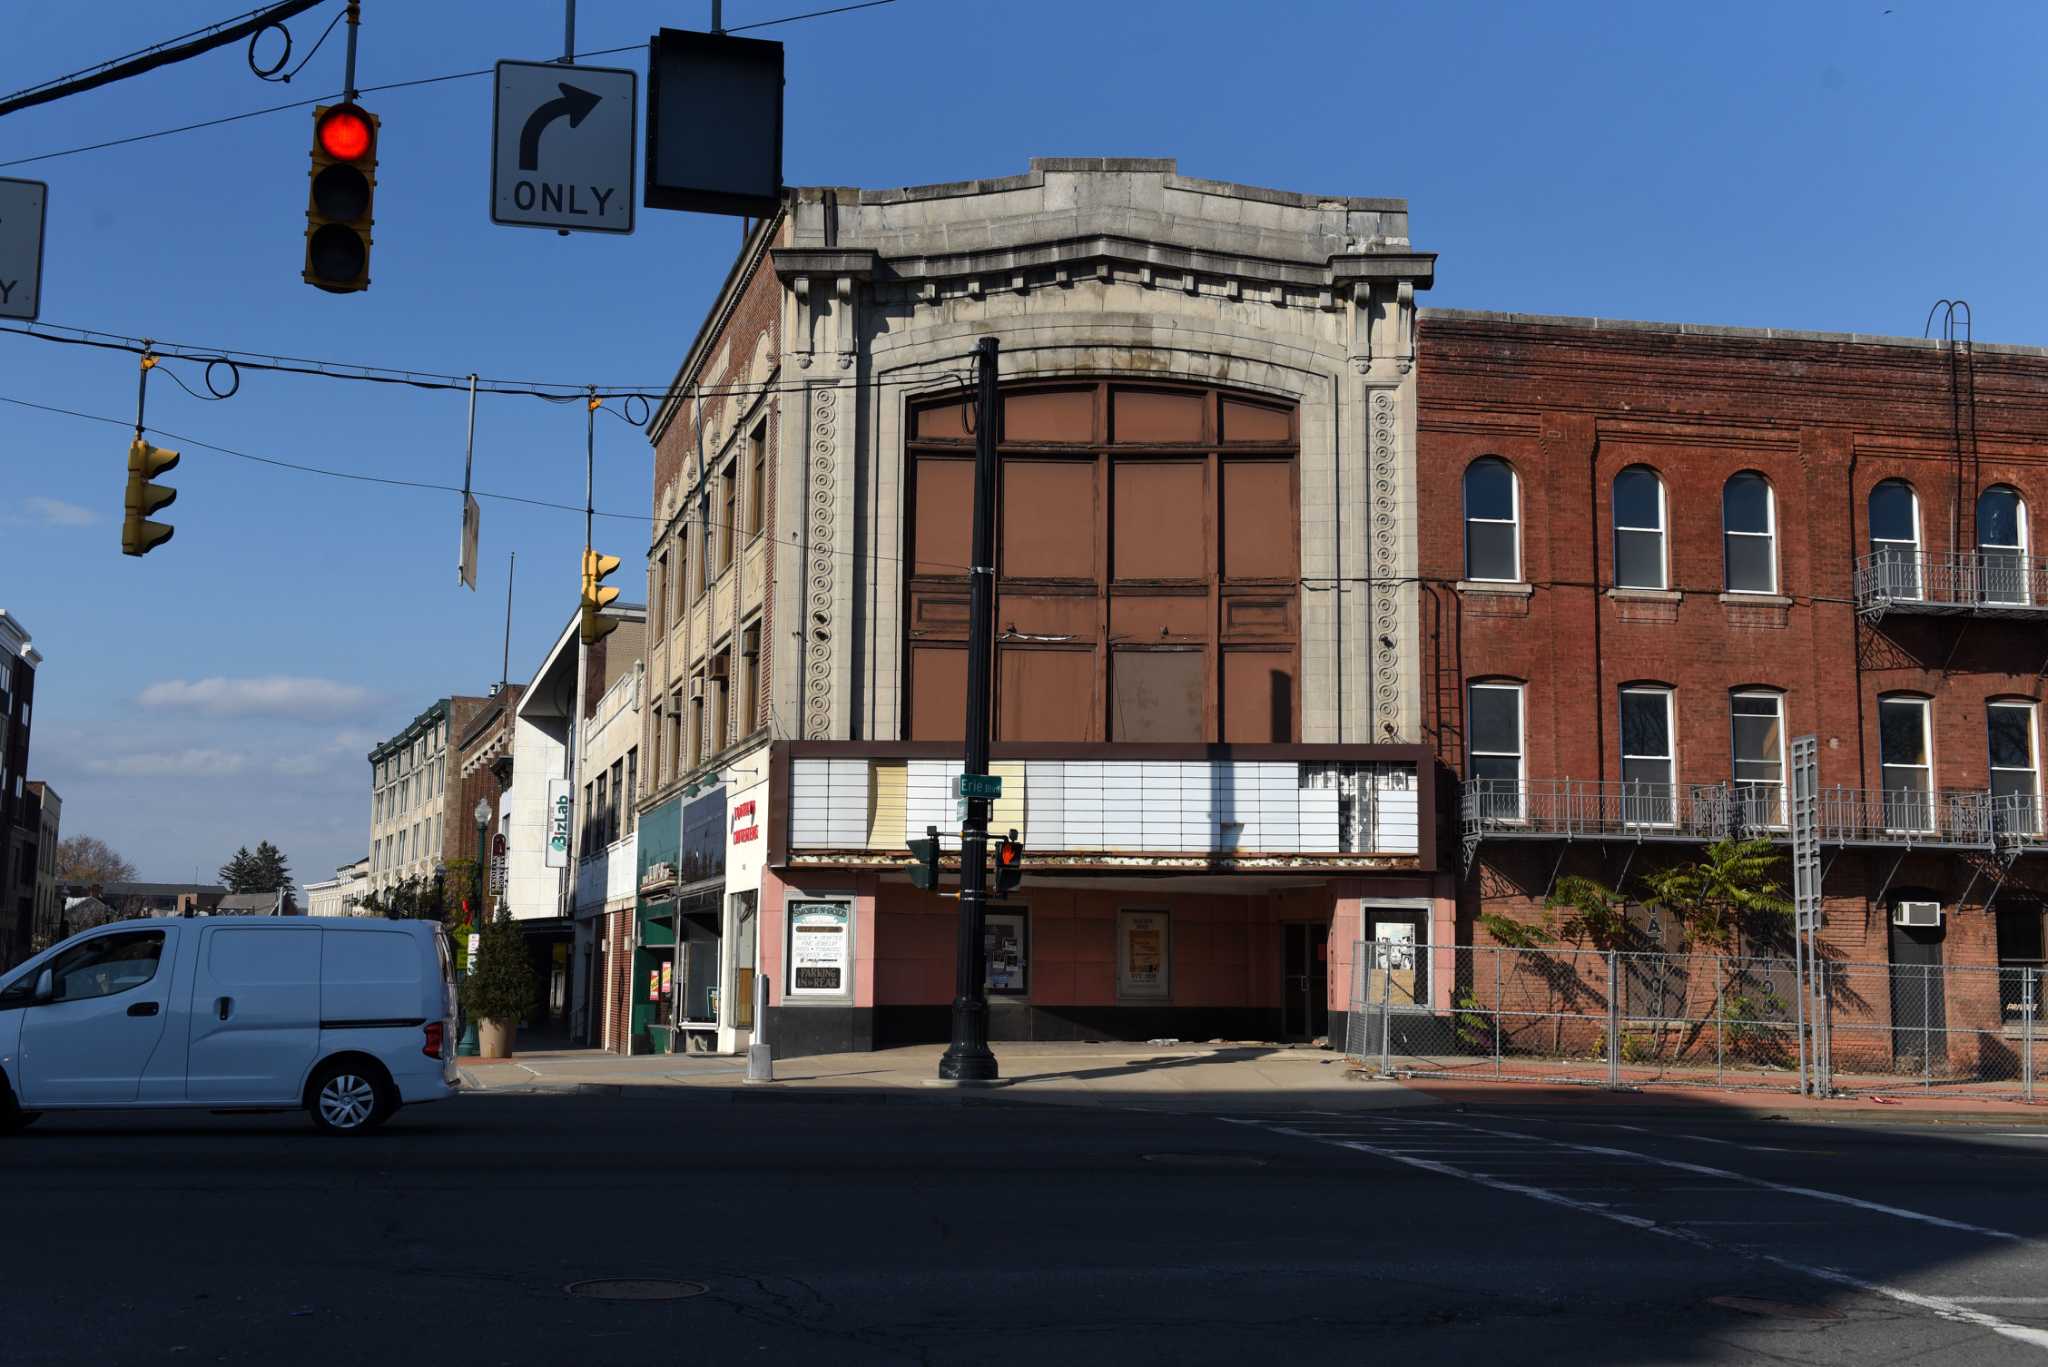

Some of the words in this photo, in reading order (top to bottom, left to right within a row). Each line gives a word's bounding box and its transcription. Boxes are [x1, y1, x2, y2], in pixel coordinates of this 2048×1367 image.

[514, 181, 615, 216] ONLY
[961, 778, 984, 793] Erie
[552, 795, 568, 848] BizLab
